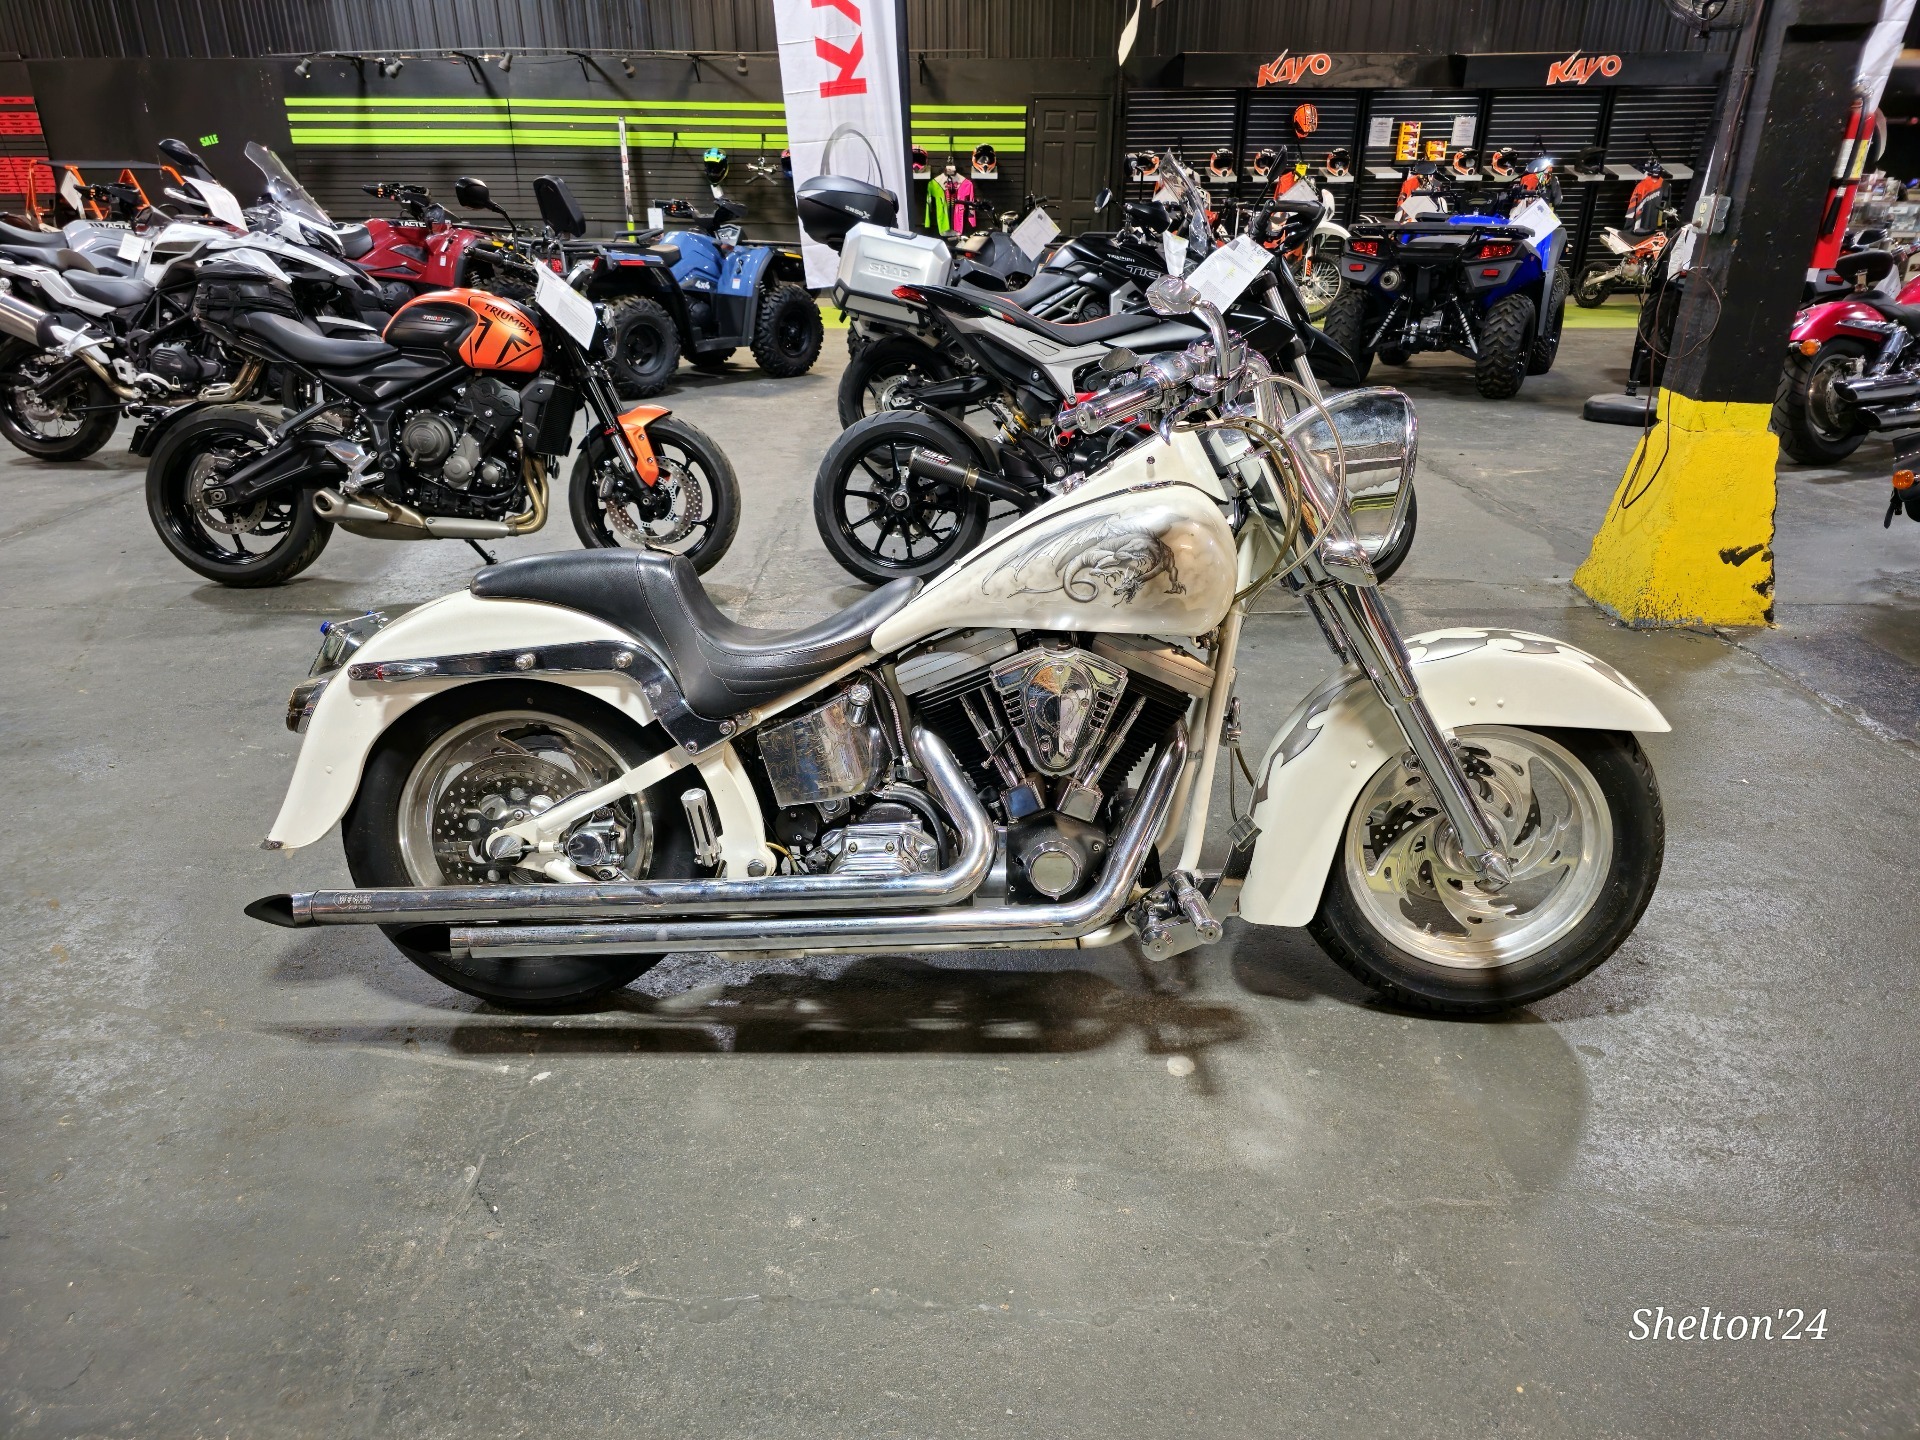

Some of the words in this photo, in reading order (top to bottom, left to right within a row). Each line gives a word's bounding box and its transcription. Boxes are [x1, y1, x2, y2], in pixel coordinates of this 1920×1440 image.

[1256, 48, 1332, 88] KAYO
[1546, 48, 1622, 85] KAYO
[200, 134, 219, 146] SALE
[1126, 264, 1161, 280] TIG
[422, 314, 451, 323] TRIDENT
[484, 303, 534, 337] TRIUMPH
